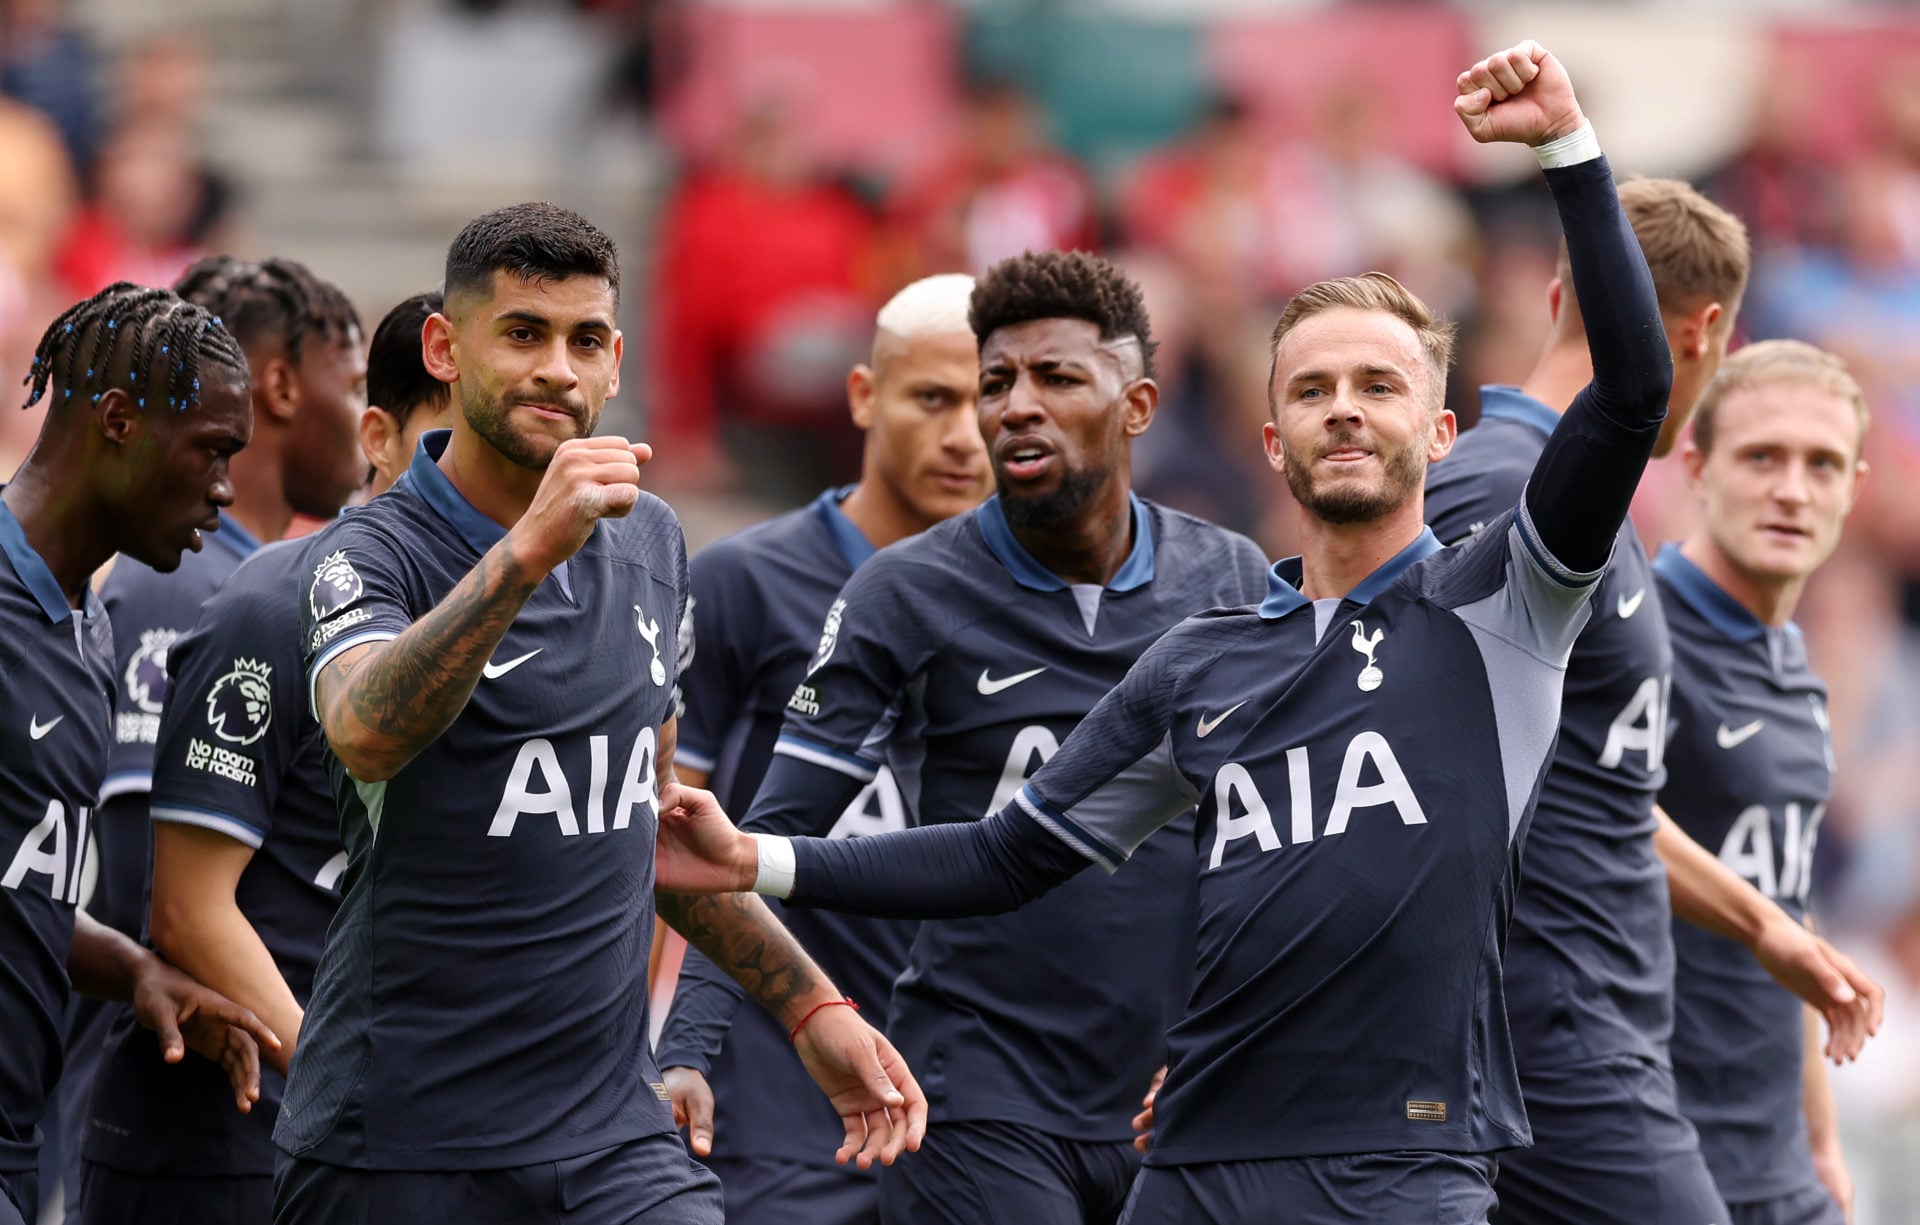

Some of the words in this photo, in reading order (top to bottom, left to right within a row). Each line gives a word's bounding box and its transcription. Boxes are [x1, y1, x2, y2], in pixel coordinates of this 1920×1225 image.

[321, 608, 363, 633] room
[185, 748, 209, 770] for
[208, 759, 257, 787] racism
[188, 738, 212, 758] No
[213, 746, 255, 772] room
[1598, 673, 1671, 772] AI
[487, 726, 660, 837] AIA
[1208, 731, 1429, 870] AIA
[0, 799, 88, 904] AI
